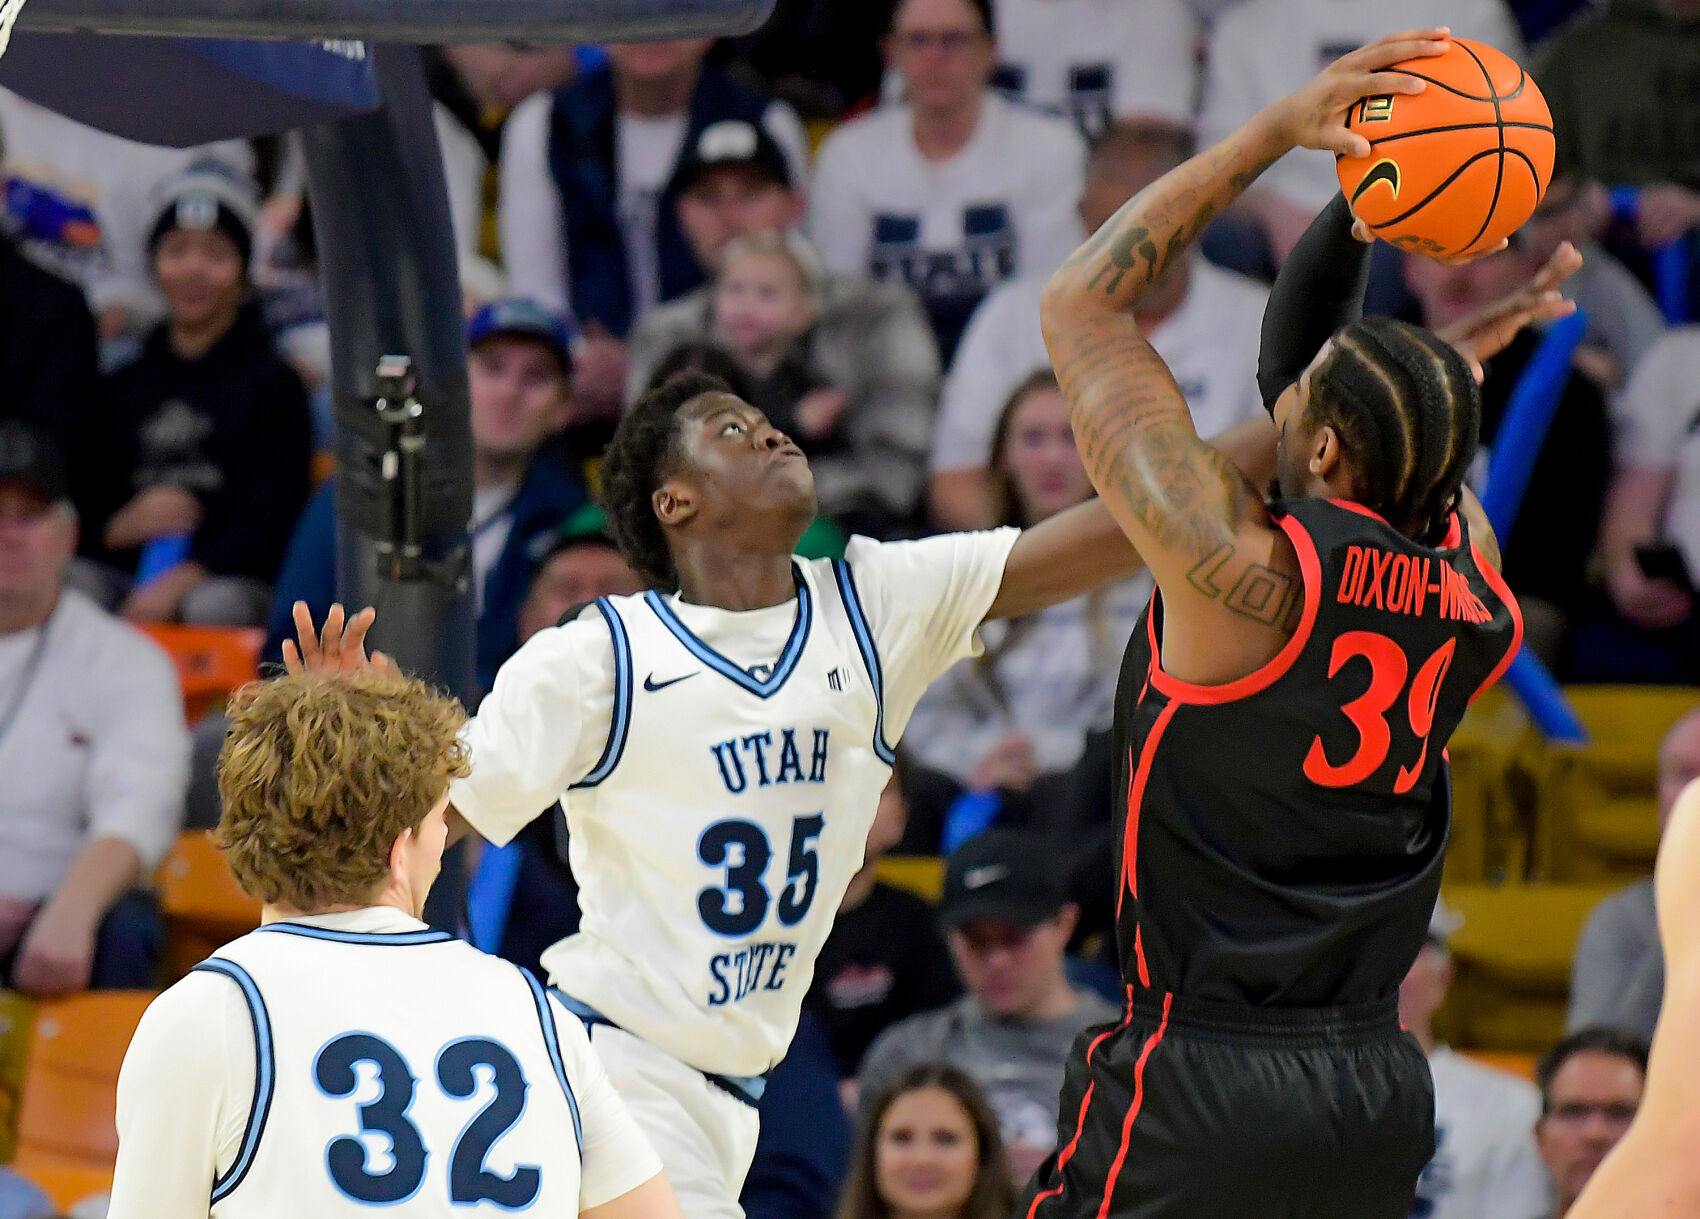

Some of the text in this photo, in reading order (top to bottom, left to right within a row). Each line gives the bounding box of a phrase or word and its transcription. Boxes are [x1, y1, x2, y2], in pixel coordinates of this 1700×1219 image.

[710, 728, 830, 794] UTAH
[1302, 630, 1457, 794] 39
[696, 812, 826, 939] 35
[311, 1029, 543, 1213] 32
